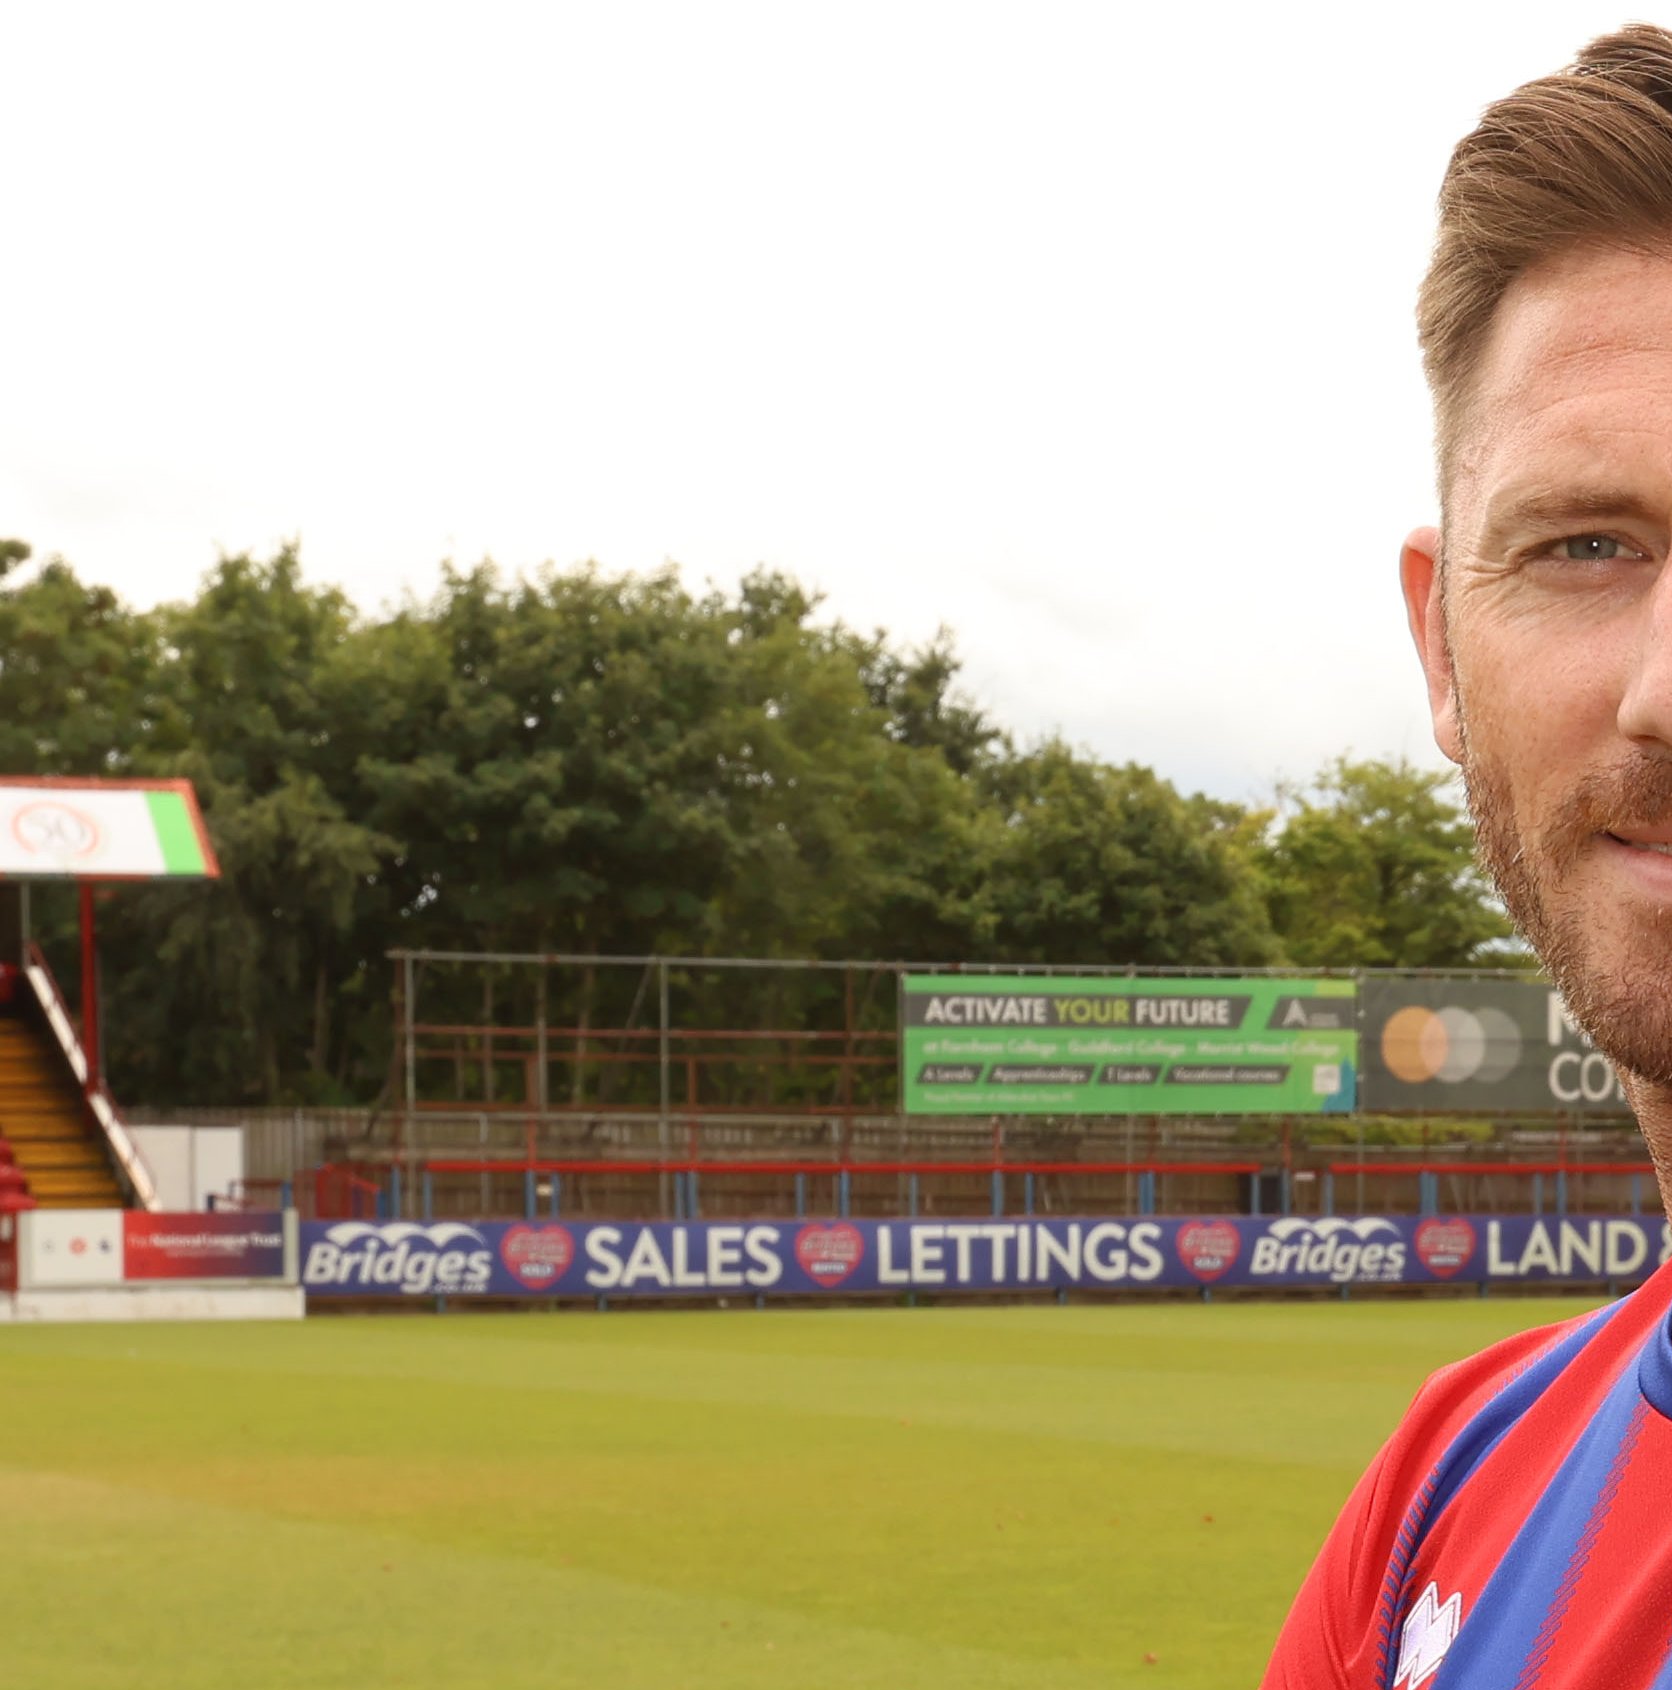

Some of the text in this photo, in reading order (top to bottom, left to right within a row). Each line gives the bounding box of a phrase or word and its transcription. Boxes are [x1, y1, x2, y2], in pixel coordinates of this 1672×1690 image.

[924, 997, 1229, 1025] ACTIVATE YOUR FUTURE
[1548, 1051, 1626, 1102] CO
[304, 1238, 492, 1293] Bridges
[585, 1226, 782, 1288] SALES
[878, 1222, 1164, 1283] LETTINGS
[1250, 1232, 1406, 1282] Bridges
[1487, 1220, 1648, 1275] LAND
